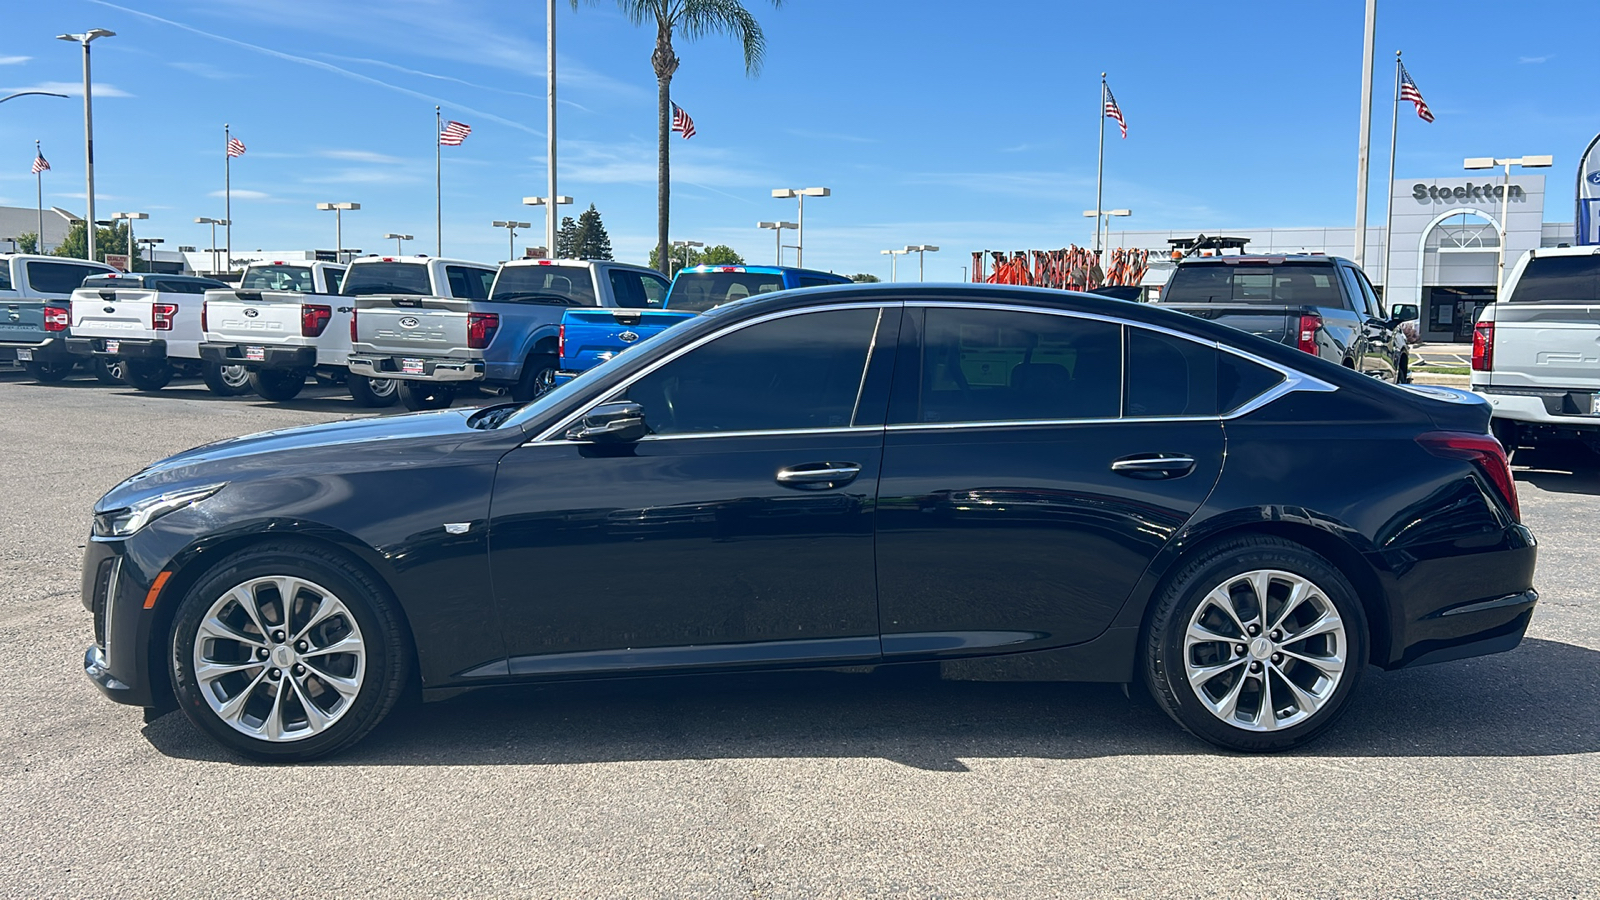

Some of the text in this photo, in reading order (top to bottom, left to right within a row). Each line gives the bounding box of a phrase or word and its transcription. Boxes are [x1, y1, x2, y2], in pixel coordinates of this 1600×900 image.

[1412, 182, 1522, 200] Stockton
[222, 320, 283, 331] F-150
[375, 328, 447, 341] F-150
